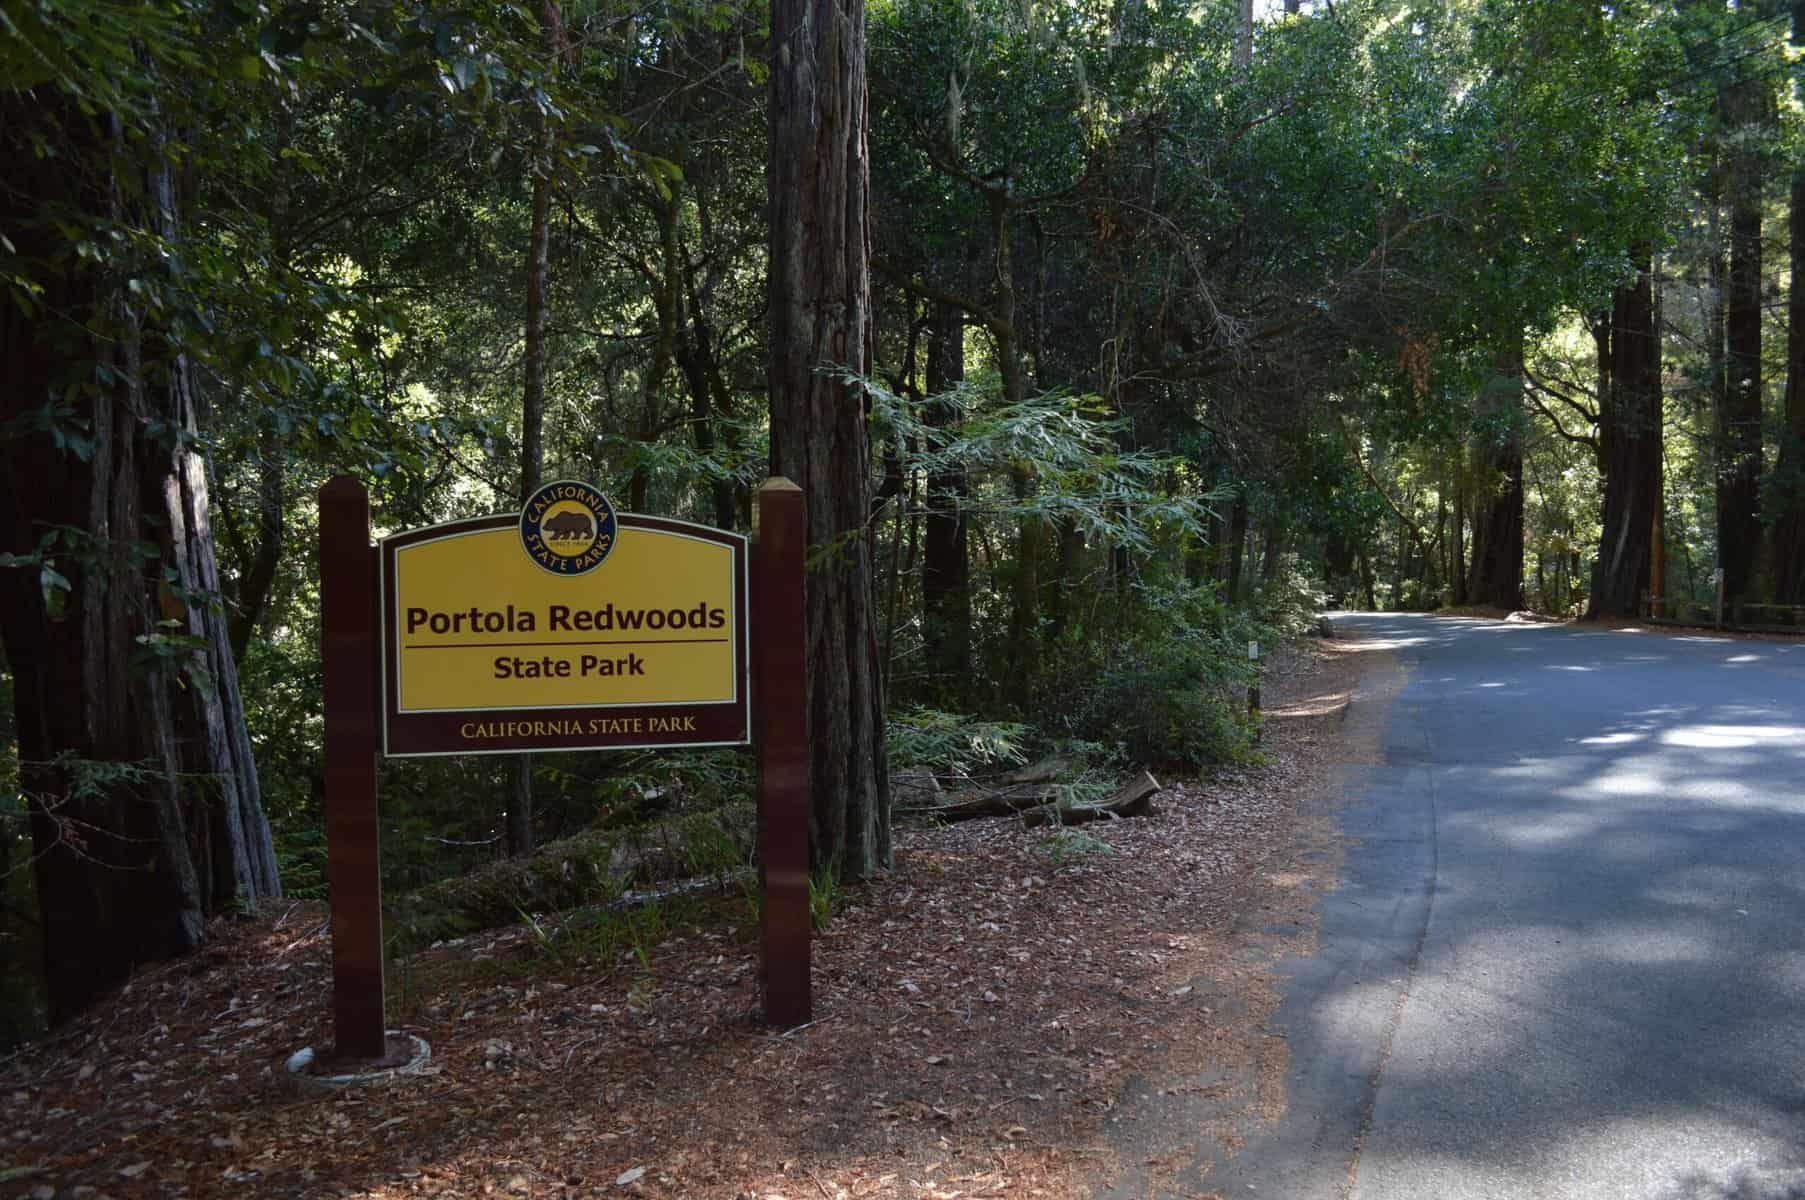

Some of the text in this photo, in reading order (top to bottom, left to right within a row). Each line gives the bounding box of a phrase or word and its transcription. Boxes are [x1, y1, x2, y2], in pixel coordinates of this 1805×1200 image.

[527, 486, 609, 524] CALIFORNIA
[527, 533, 610, 571] STATE PARKS
[407, 602, 725, 635] Portola Redwoods
[494, 653, 644, 679] State Park
[461, 716, 696, 739] CALIFORNIA STATE PARK
